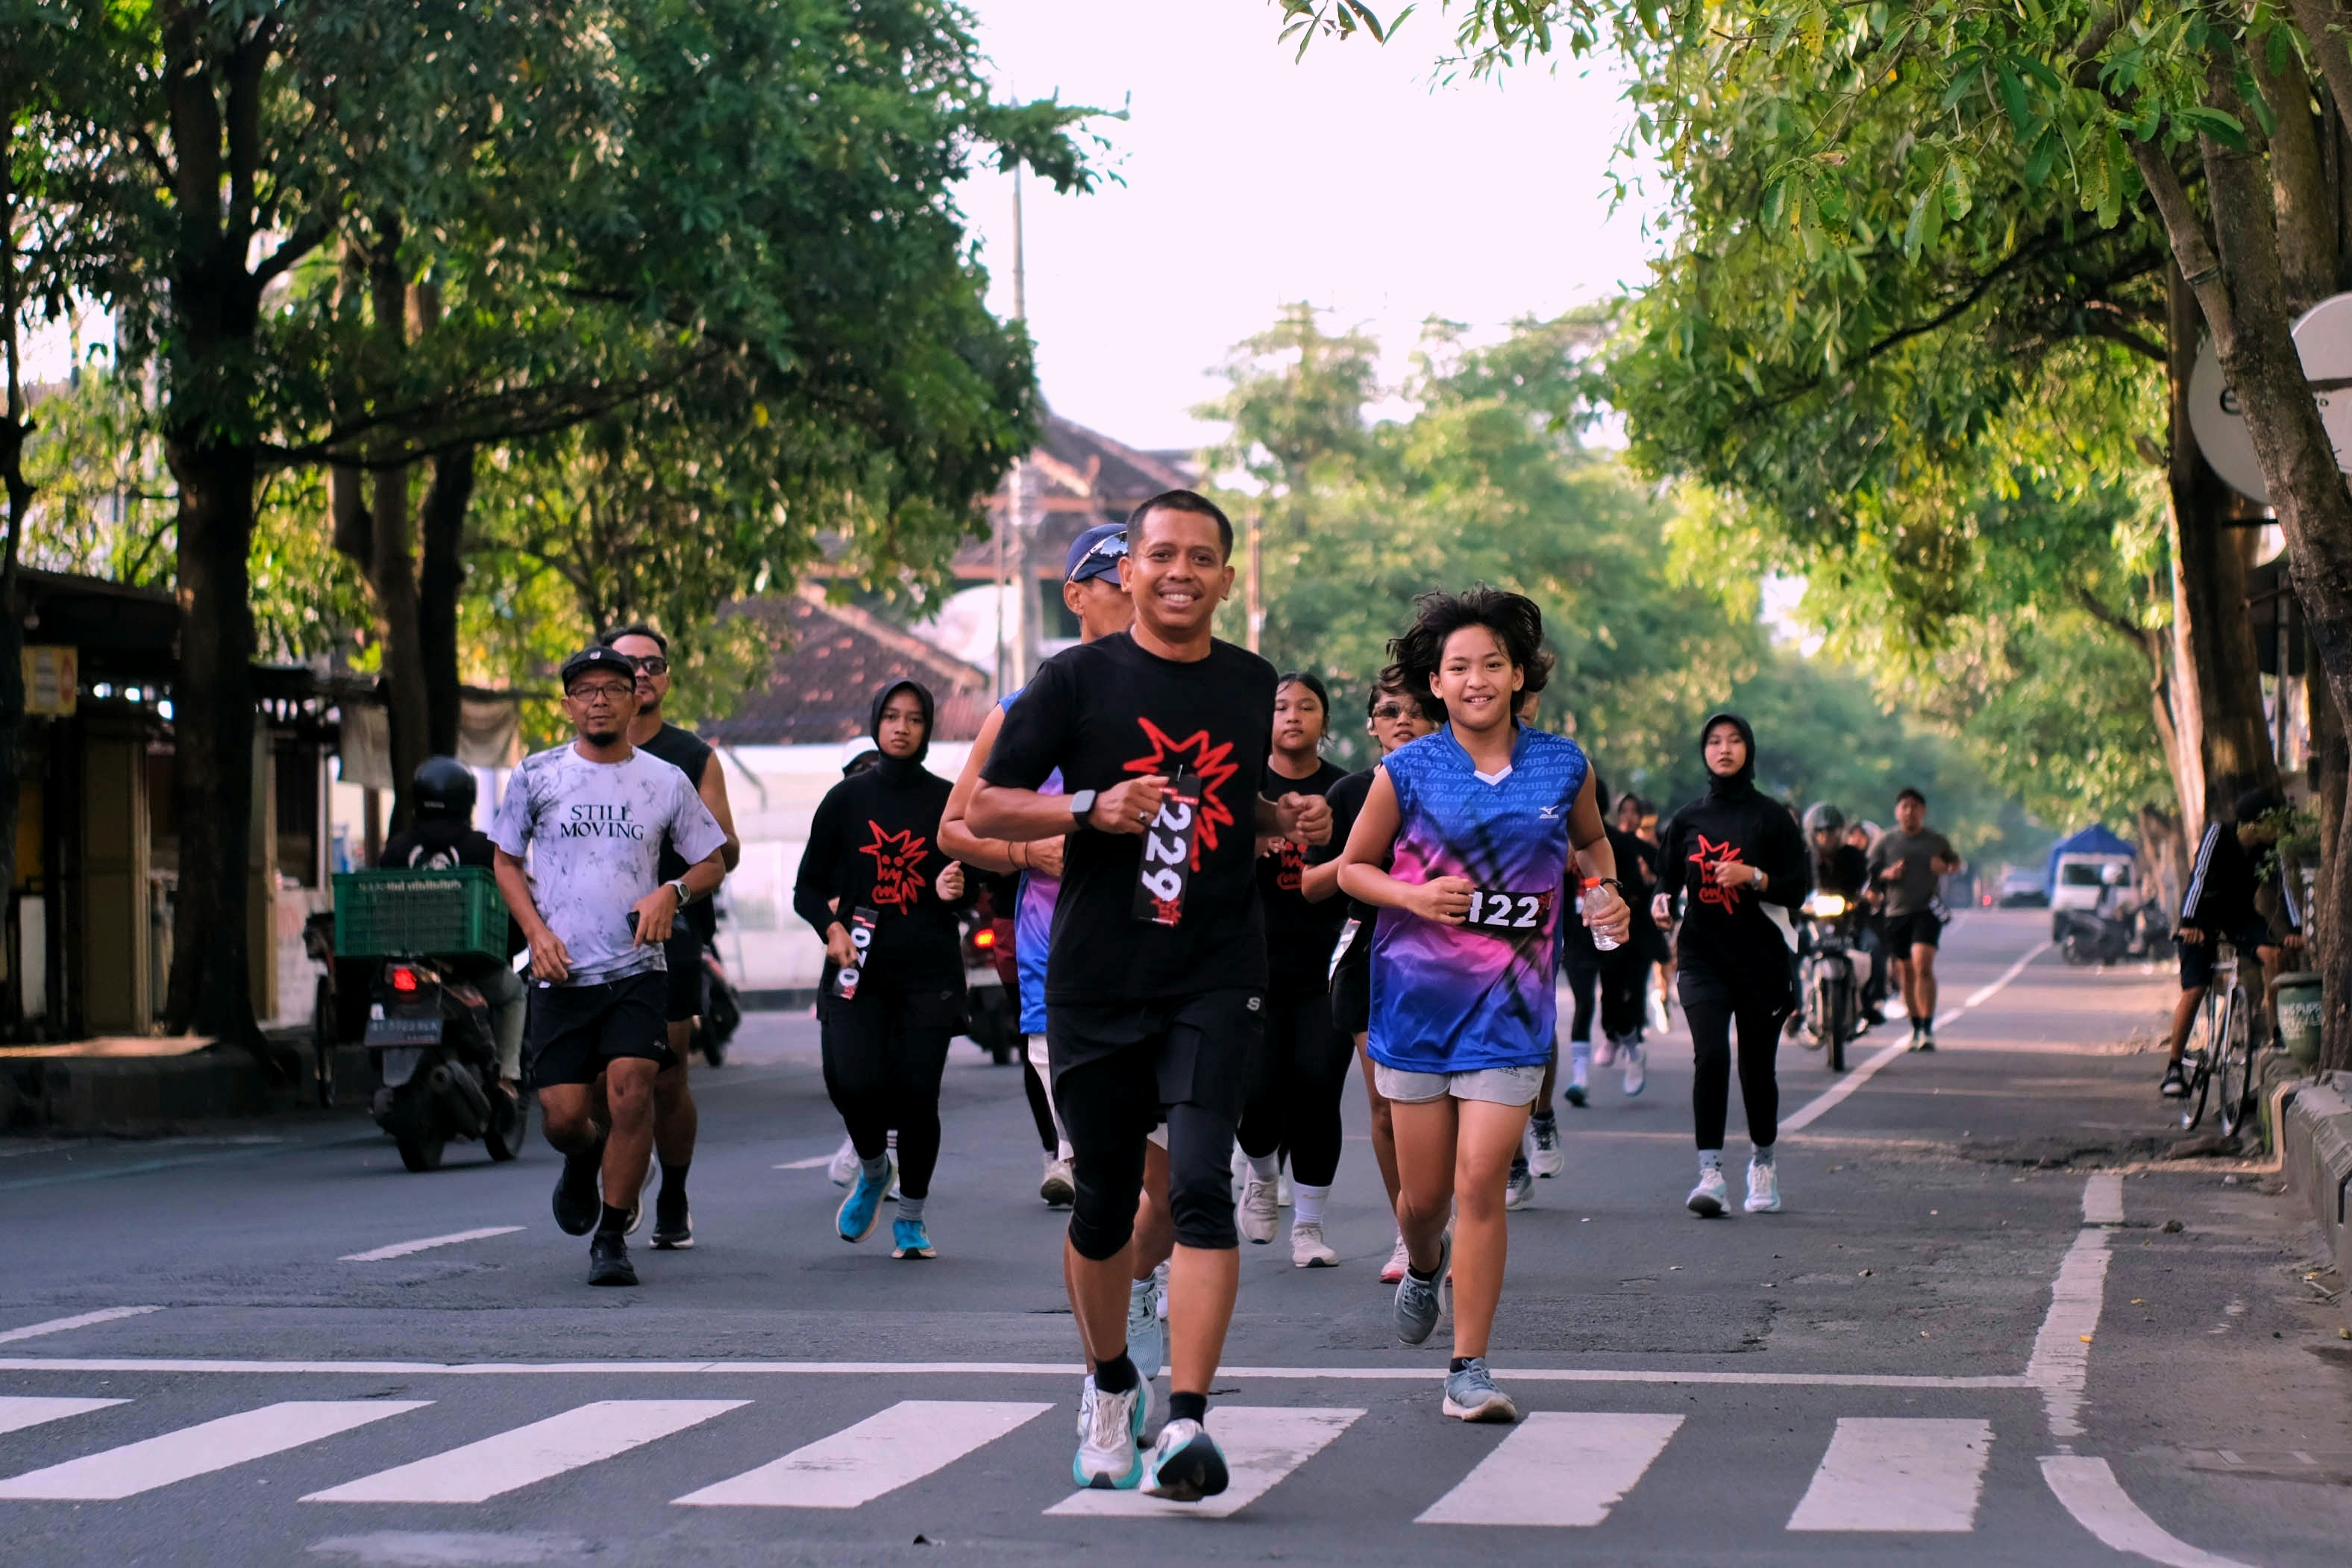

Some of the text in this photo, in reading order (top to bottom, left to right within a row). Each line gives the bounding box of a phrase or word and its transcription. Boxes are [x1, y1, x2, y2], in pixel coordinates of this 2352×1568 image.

[570, 804, 633, 822] STILL
[560, 821, 644, 841] MOVING
[1141, 803, 1192, 902] 229
[1468, 891, 1540, 928] 122
